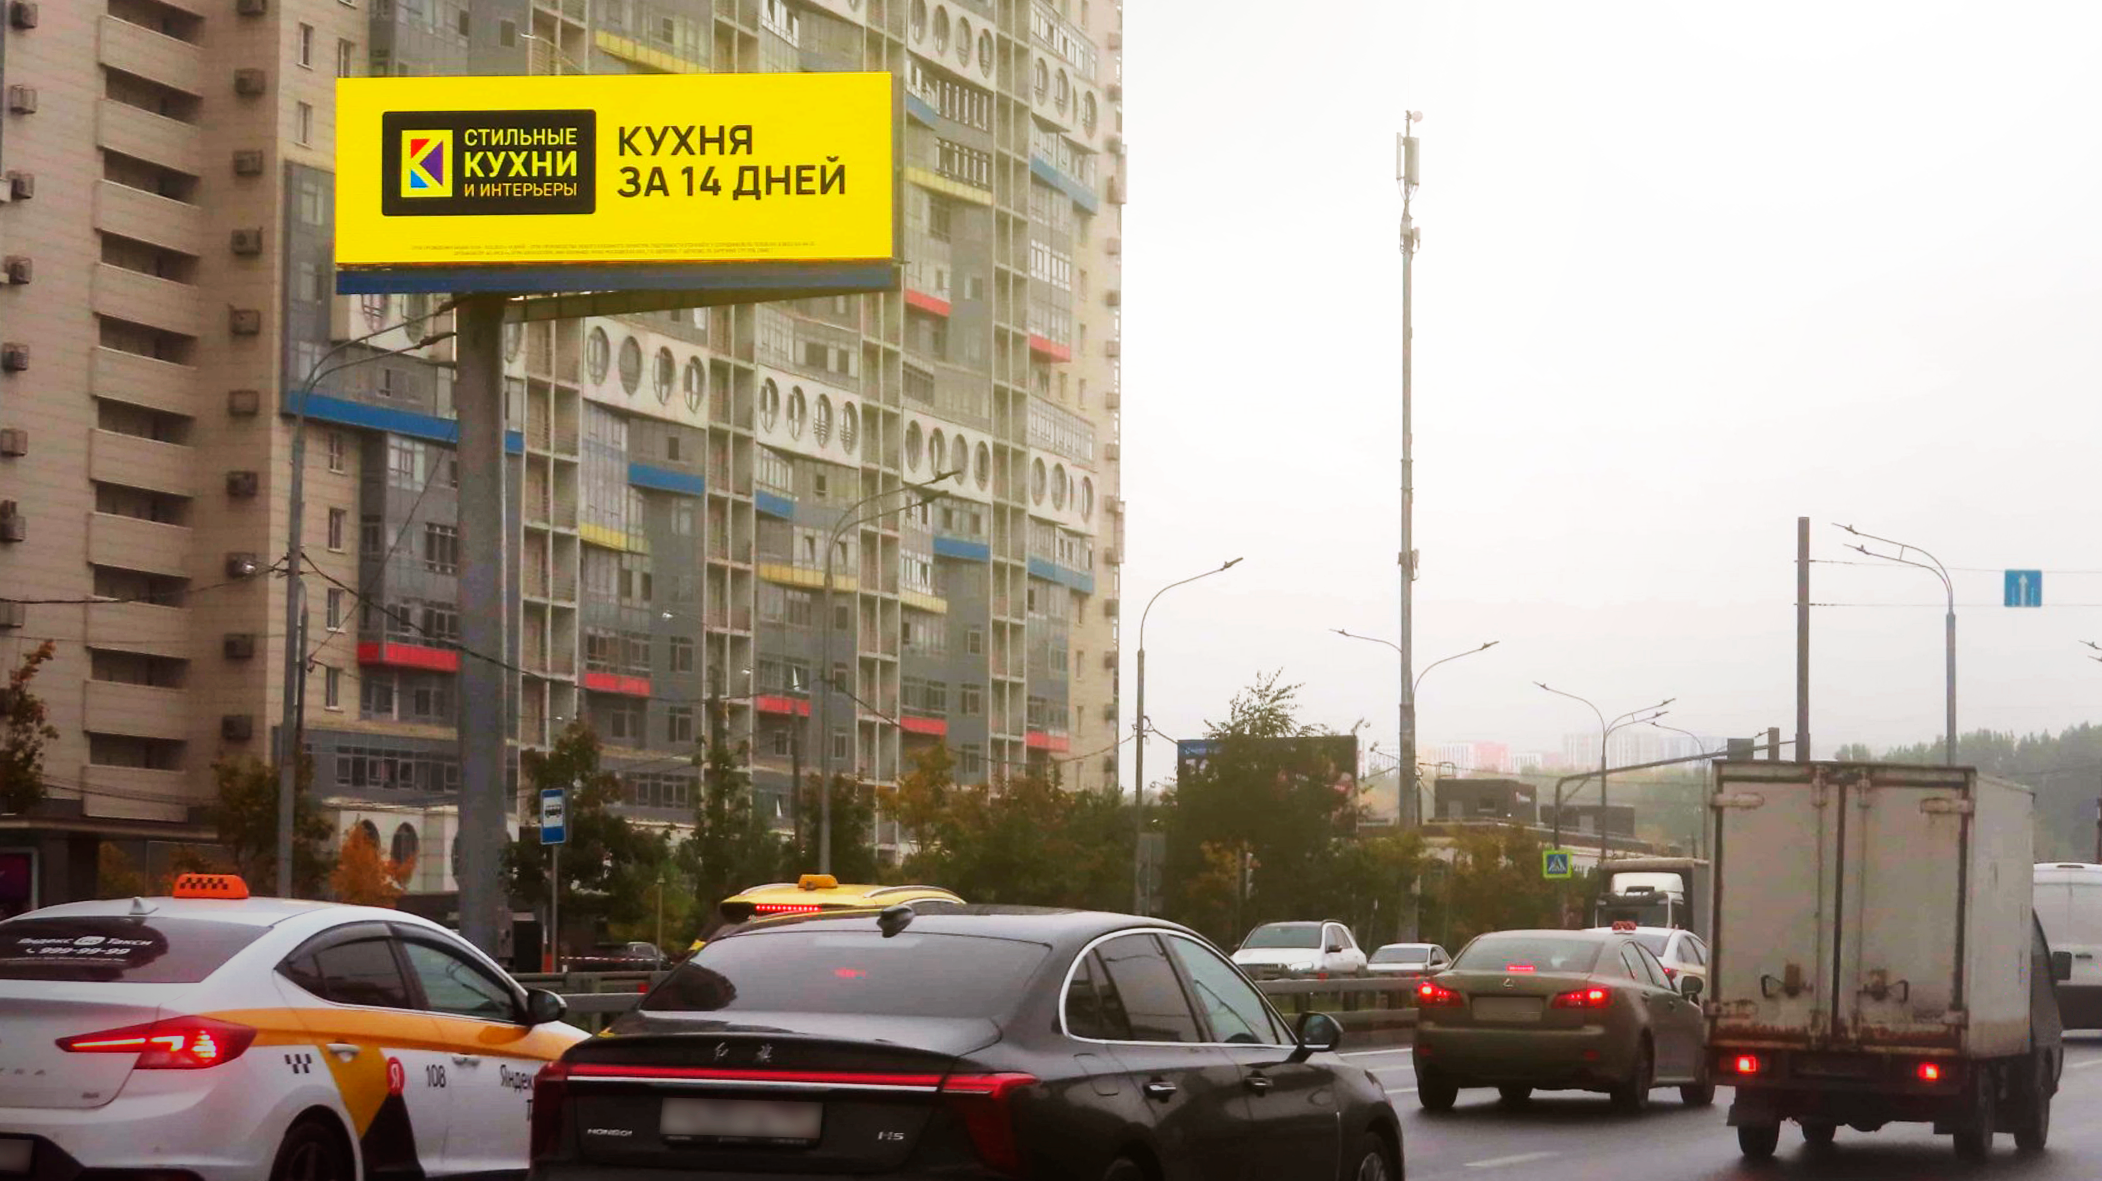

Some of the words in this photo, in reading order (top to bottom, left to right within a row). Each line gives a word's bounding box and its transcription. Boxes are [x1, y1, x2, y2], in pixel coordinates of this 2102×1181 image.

[464, 127, 578, 146] СТИЛЬНЫЕ
[618, 124, 753, 157] КУХНЯ
[464, 150, 577, 178] КУХНИ
[464, 183, 475, 197] И
[479, 182, 577, 197] ИНТЕРЬЕРЫ
[617, 166, 670, 198] ЗА
[681, 166, 722, 197] 14
[732, 155, 846, 201] ДНЕЙ
[39, 947, 131, 955] 999-99-99
[425, 1064, 447, 1088] 108
